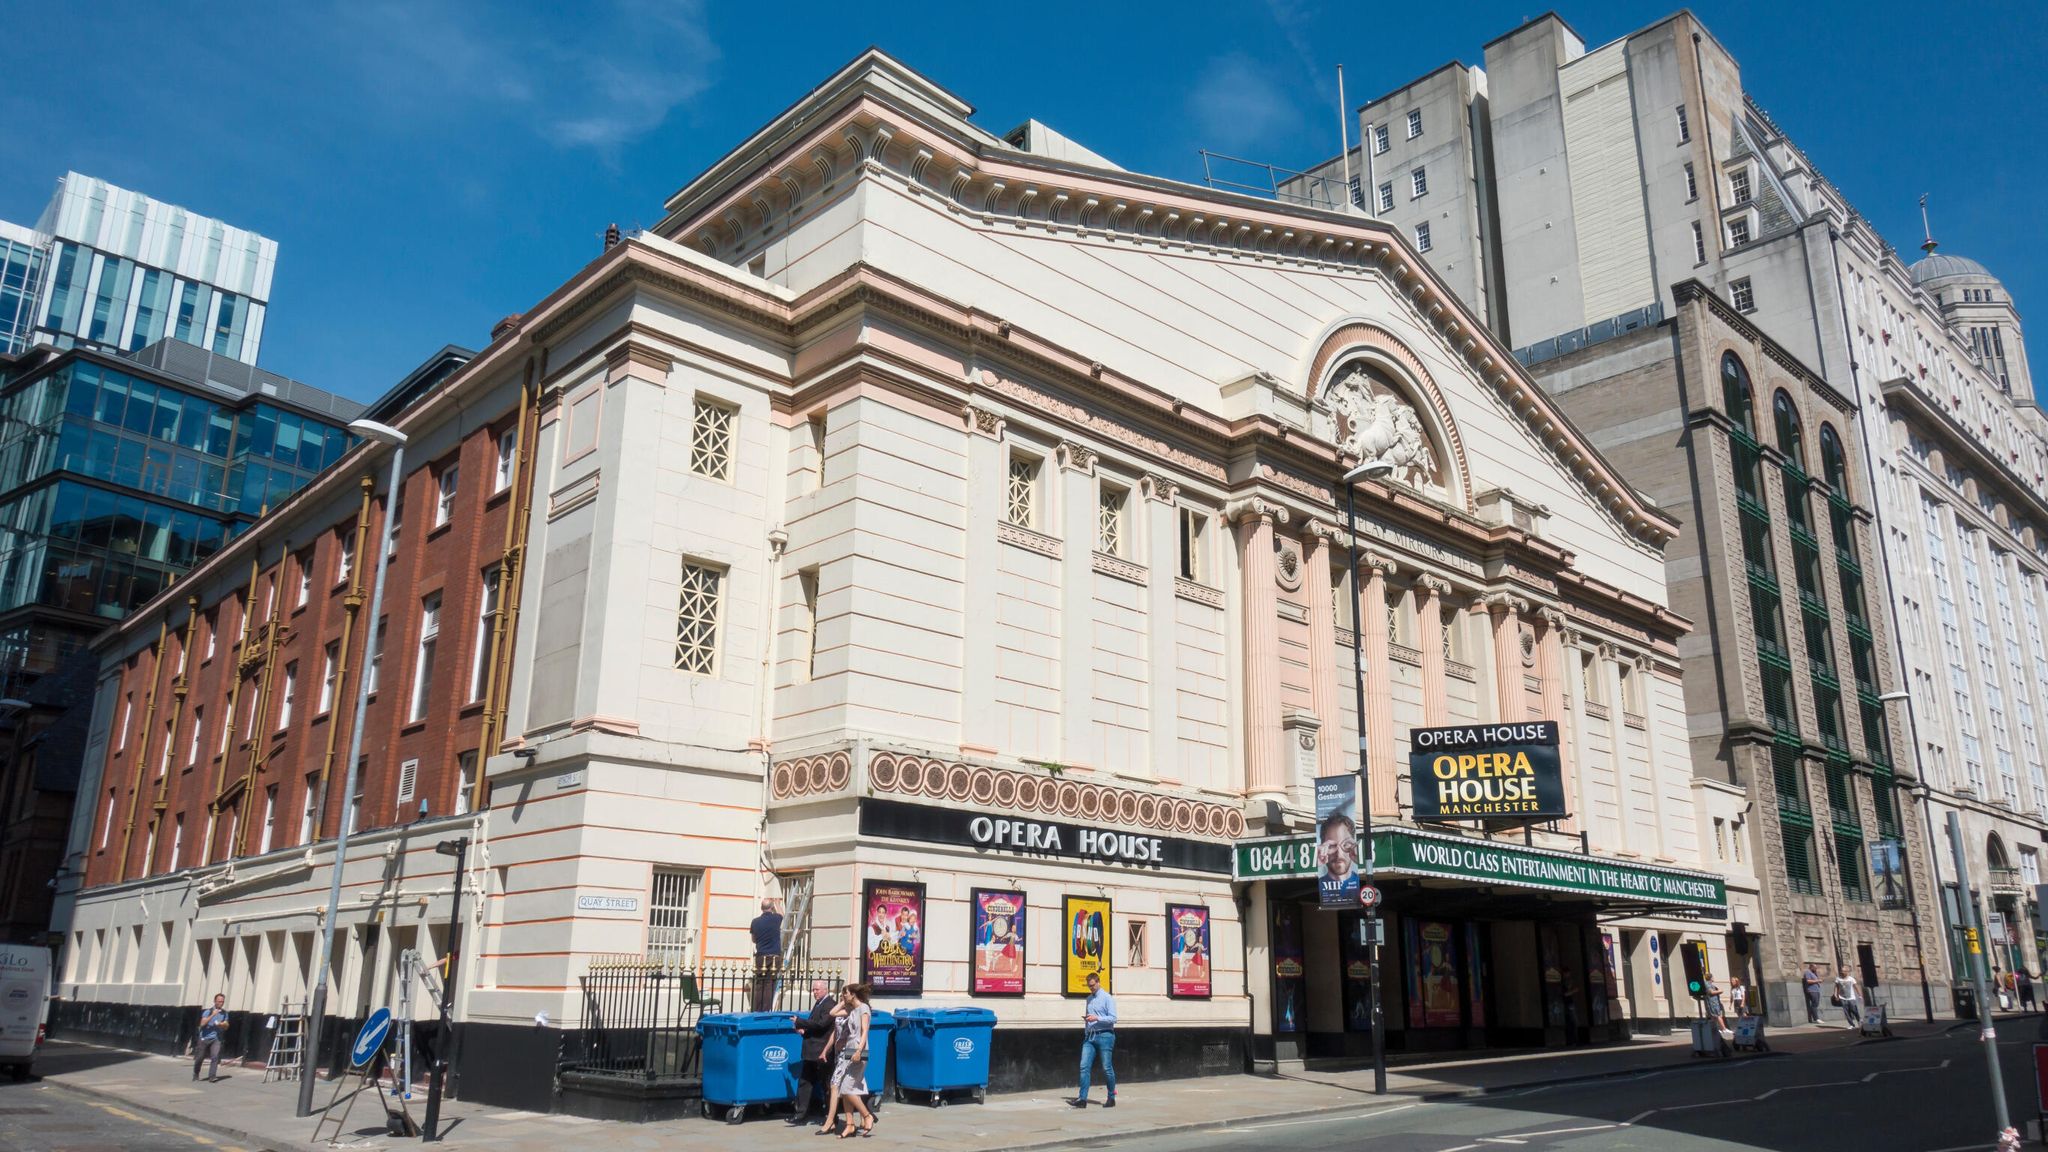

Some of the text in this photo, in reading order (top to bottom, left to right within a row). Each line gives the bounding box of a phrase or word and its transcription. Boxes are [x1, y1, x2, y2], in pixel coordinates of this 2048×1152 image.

[1418, 724, 1547, 746] OPERA HOUSE
[1433, 751, 1535, 780] OPERA
[1317, 784, 1338, 793] 10000
[1317, 790, 1346, 801] Gestures
[1438, 776, 1537, 804] HOUSE
[1439, 801, 1540, 815] MANCHESTER
[969, 816, 1164, 862] OPERA HOUSE
[1250, 844, 1296, 872] 0844
[1412, 842, 1717, 900] WORLD CLASS ENTERTAINMENT IN THE HEART OF MANCHESTER
[580, 897, 635, 909] QUAY STREET
[1361, 890, 1374, 900] 20
